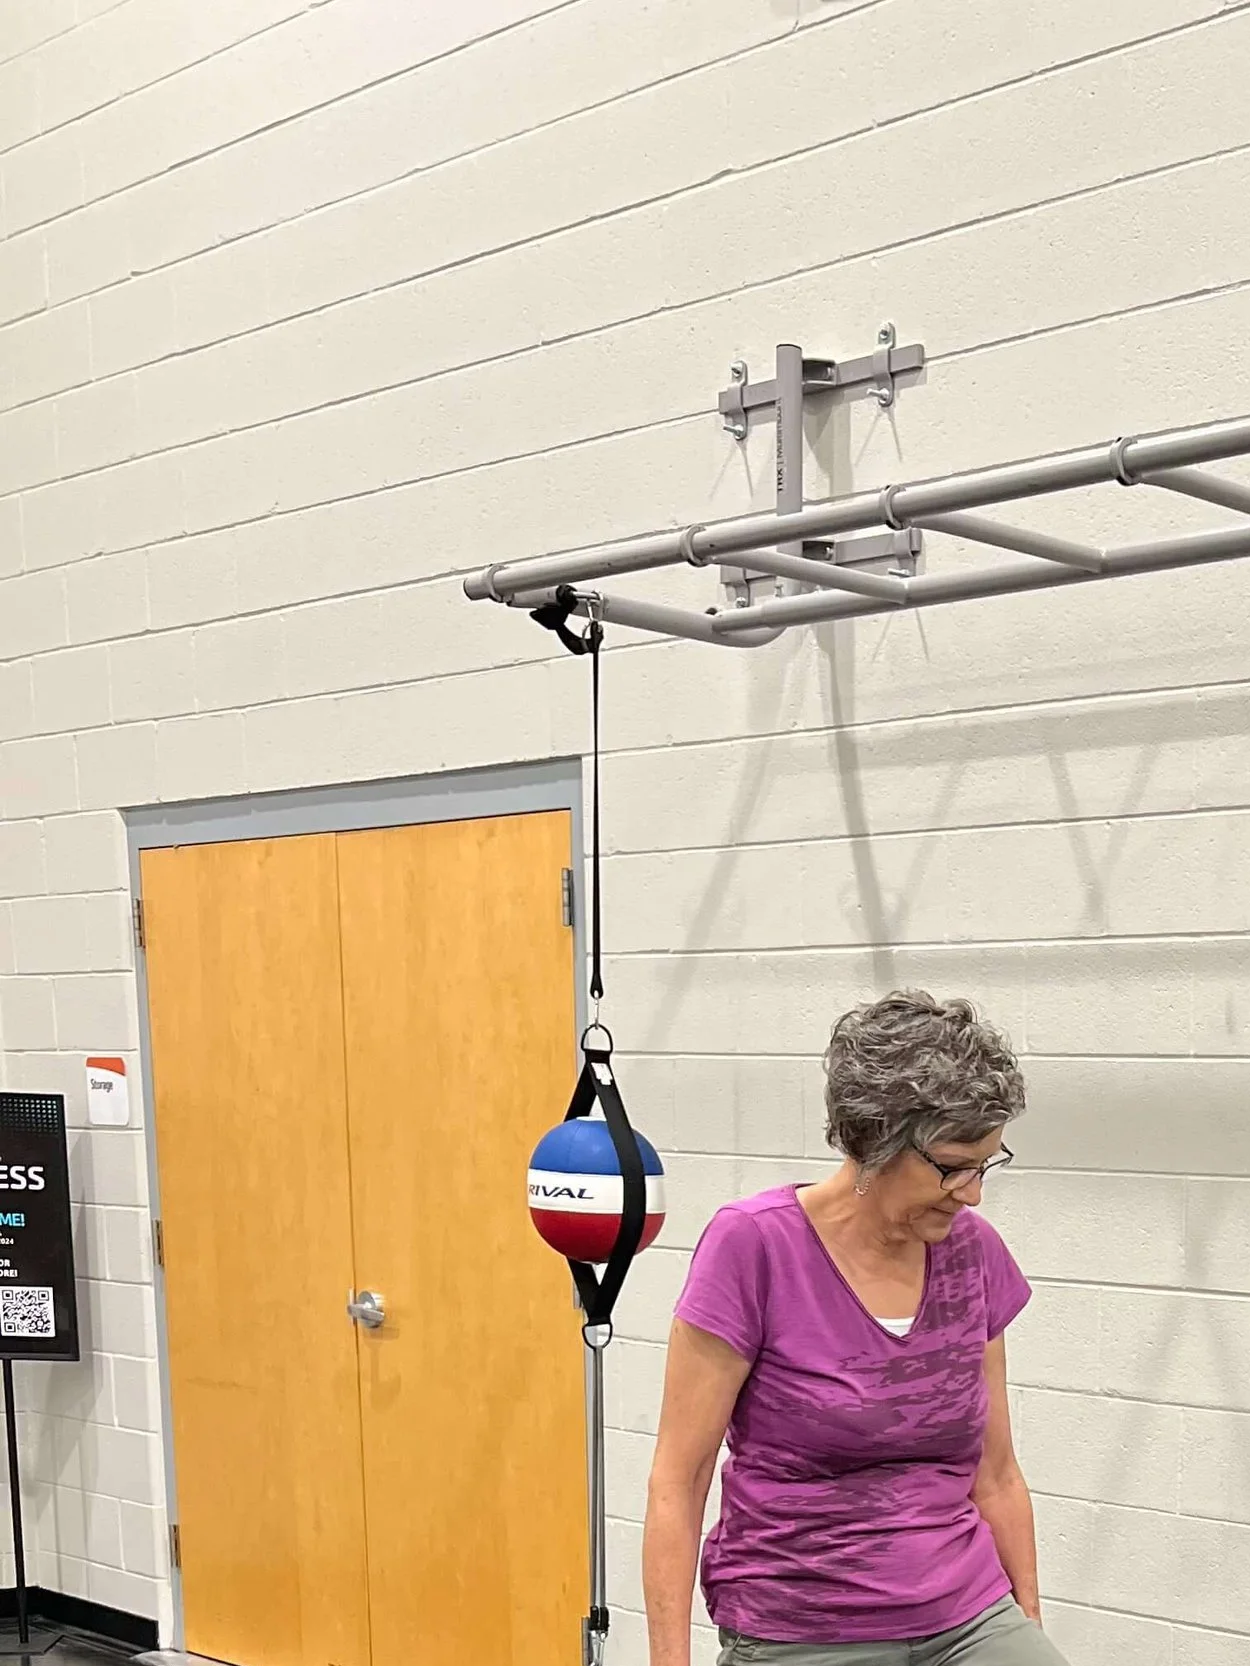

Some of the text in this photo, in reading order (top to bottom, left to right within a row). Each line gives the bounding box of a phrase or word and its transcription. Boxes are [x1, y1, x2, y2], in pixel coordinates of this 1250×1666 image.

[90, 1078, 113, 1093] Storage
[0, 1165, 45, 1190] ESS
[529, 1184, 594, 1199] RIVAL
